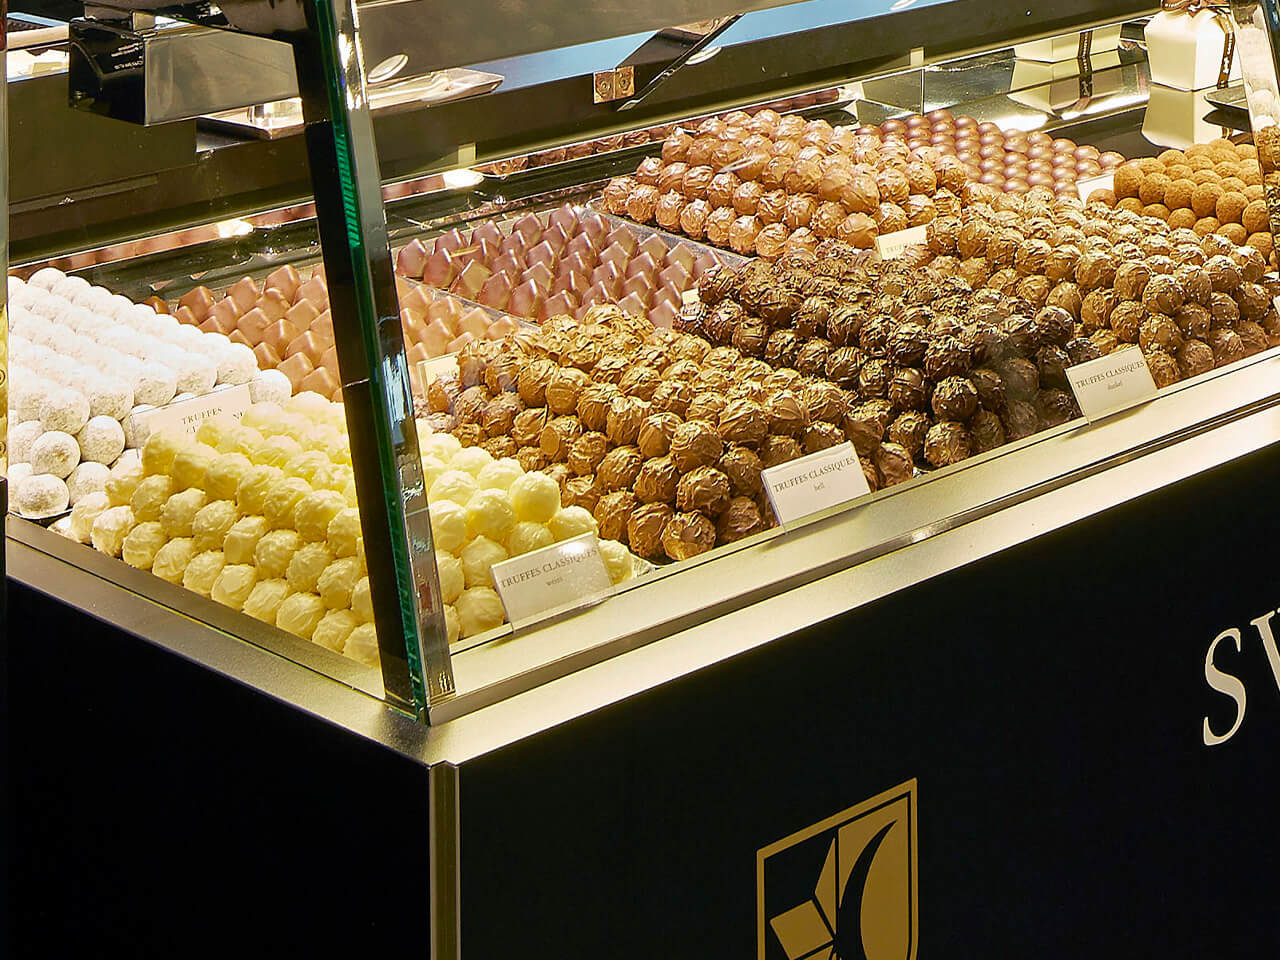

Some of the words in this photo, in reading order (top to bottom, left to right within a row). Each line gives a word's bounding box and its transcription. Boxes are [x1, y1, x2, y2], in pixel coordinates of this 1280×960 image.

[1075, 374, 1105, 388] TRUFFES
[1105, 360, 1145, 378] CLASSIQUES
[773, 474, 808, 493] TRUFFES
[809, 456, 856, 480] CLASSIQUES
[500, 568, 541, 588] TRUFFES
[542, 549, 598, 573] CLASSIQUES
